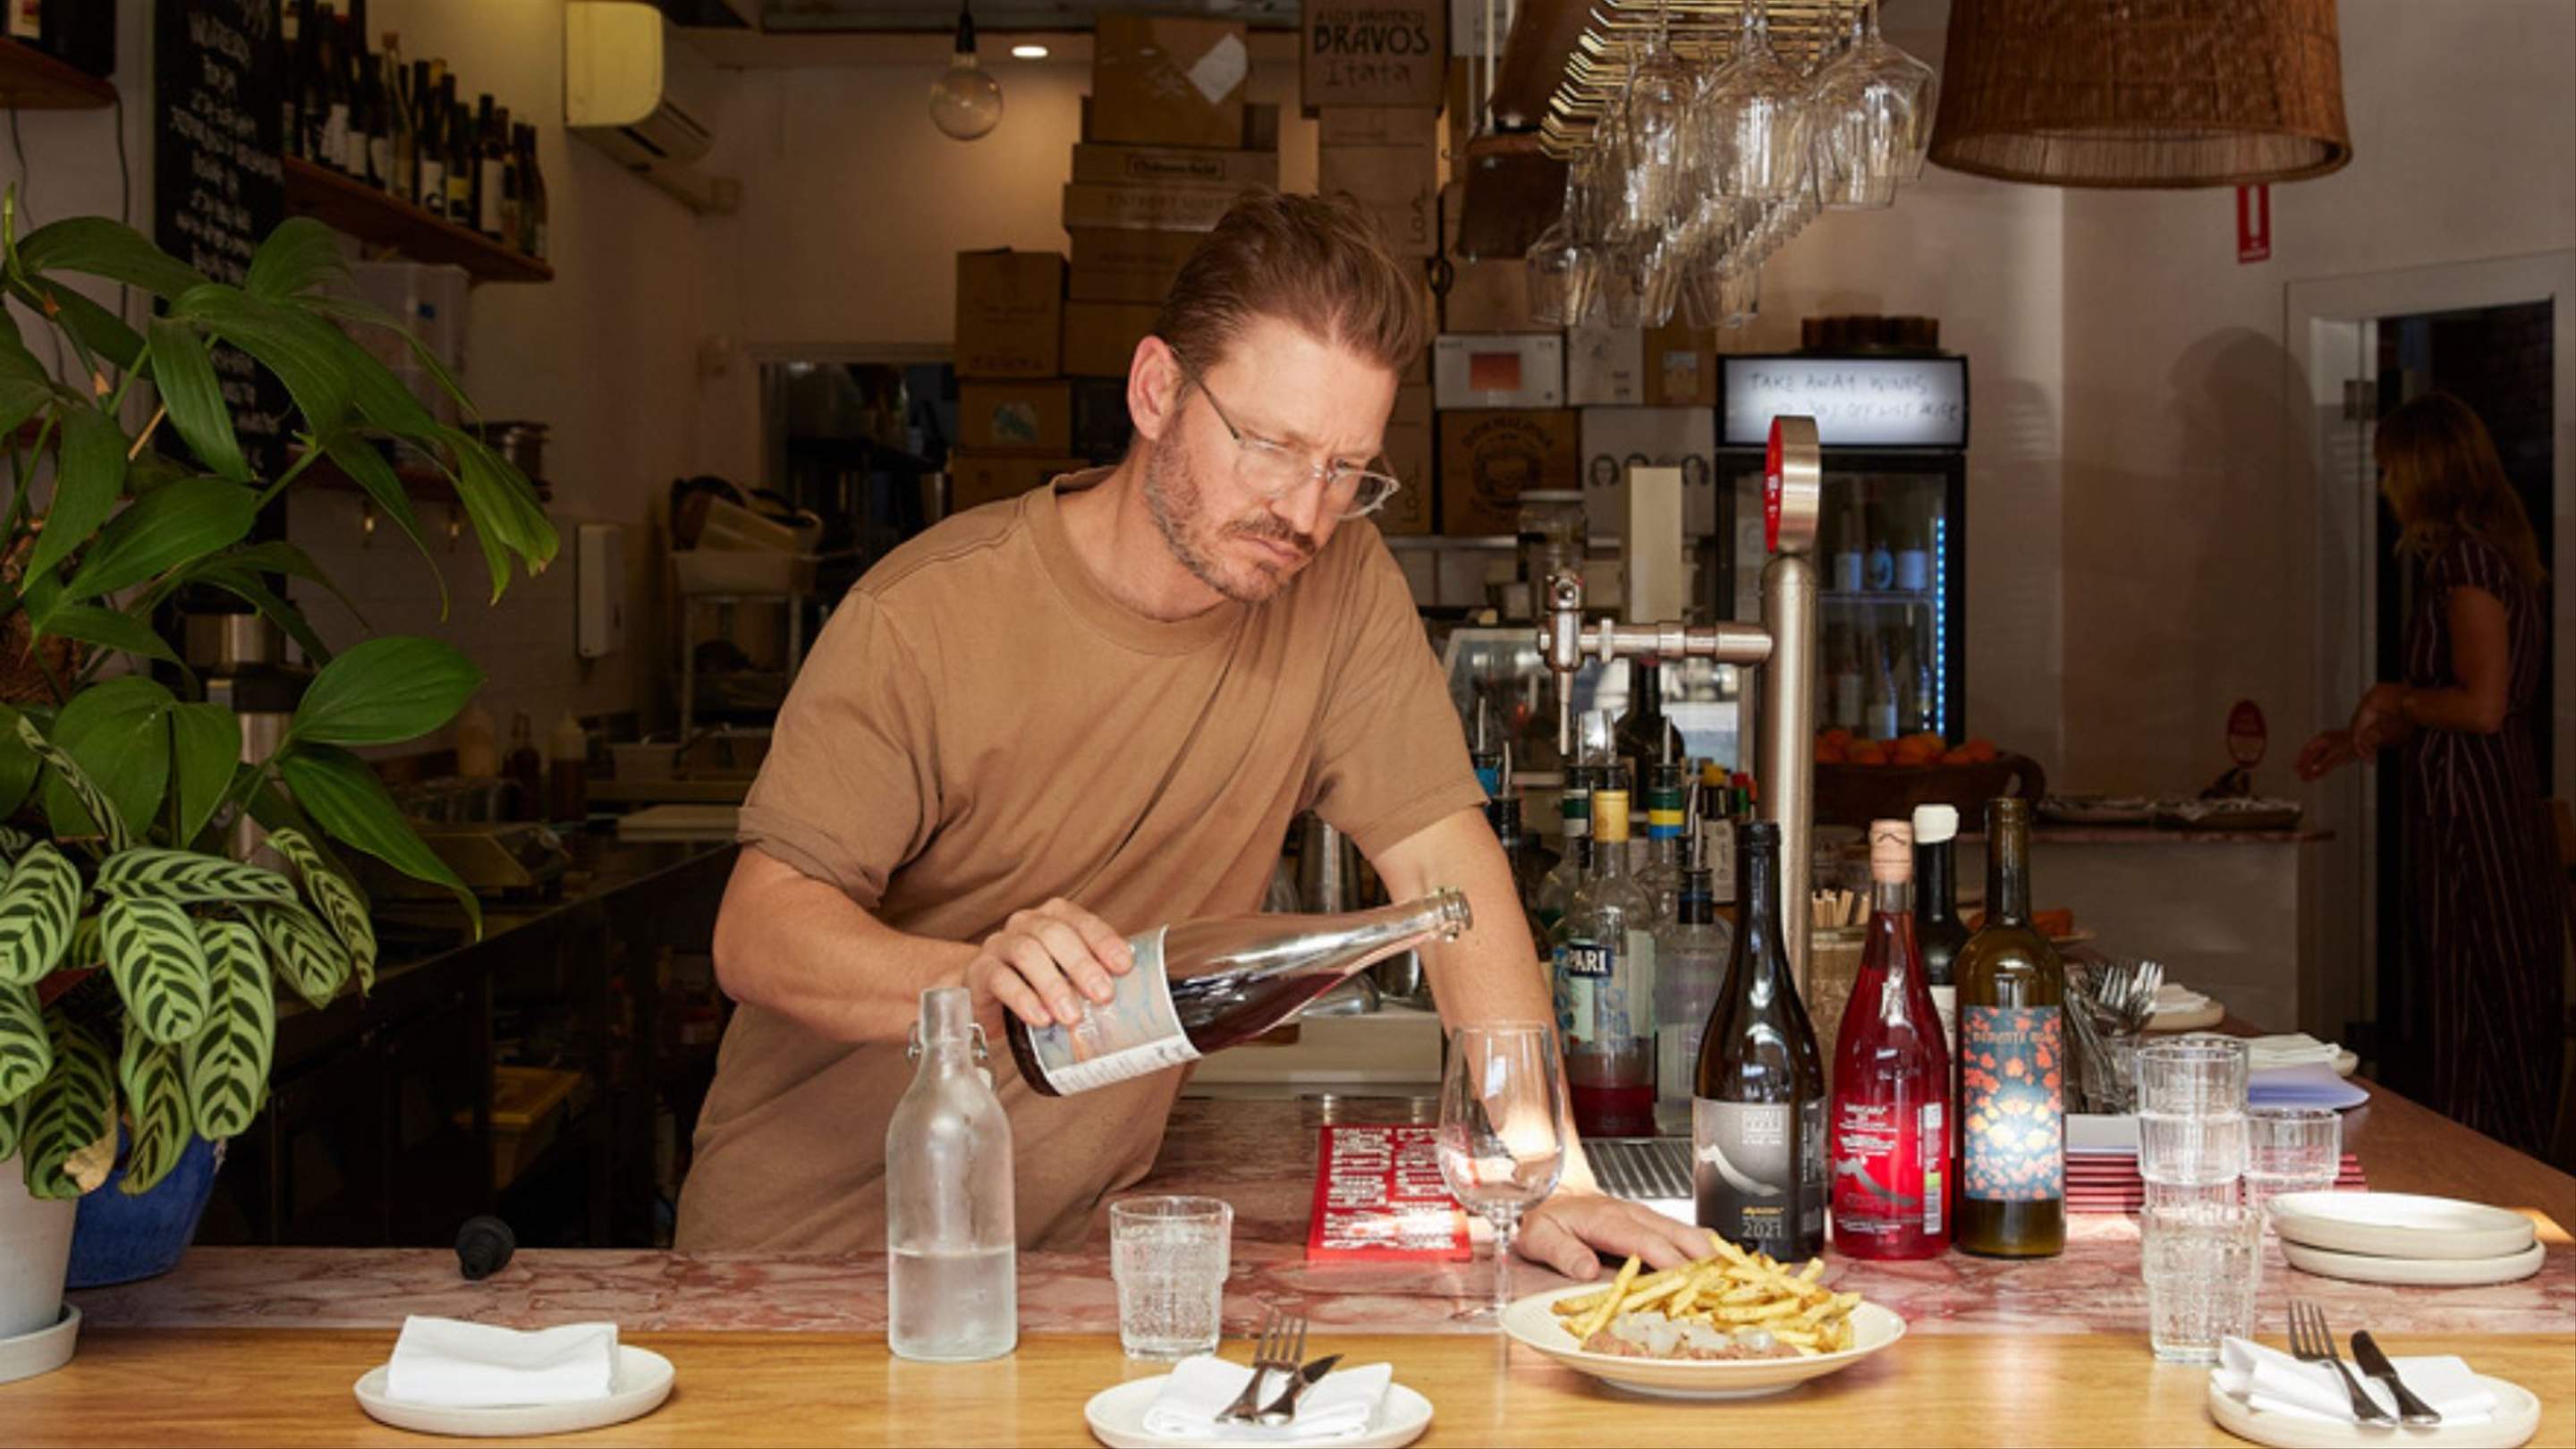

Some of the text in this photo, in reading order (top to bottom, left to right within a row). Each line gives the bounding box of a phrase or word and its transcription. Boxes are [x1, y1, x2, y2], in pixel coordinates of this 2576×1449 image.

[1313, 25, 1431, 55] BRAVOS
[1750, 373, 1794, 392] TAKE
[1806, 373, 1856, 390] AWAY
[1742, 1223, 1782, 1238] 2021
